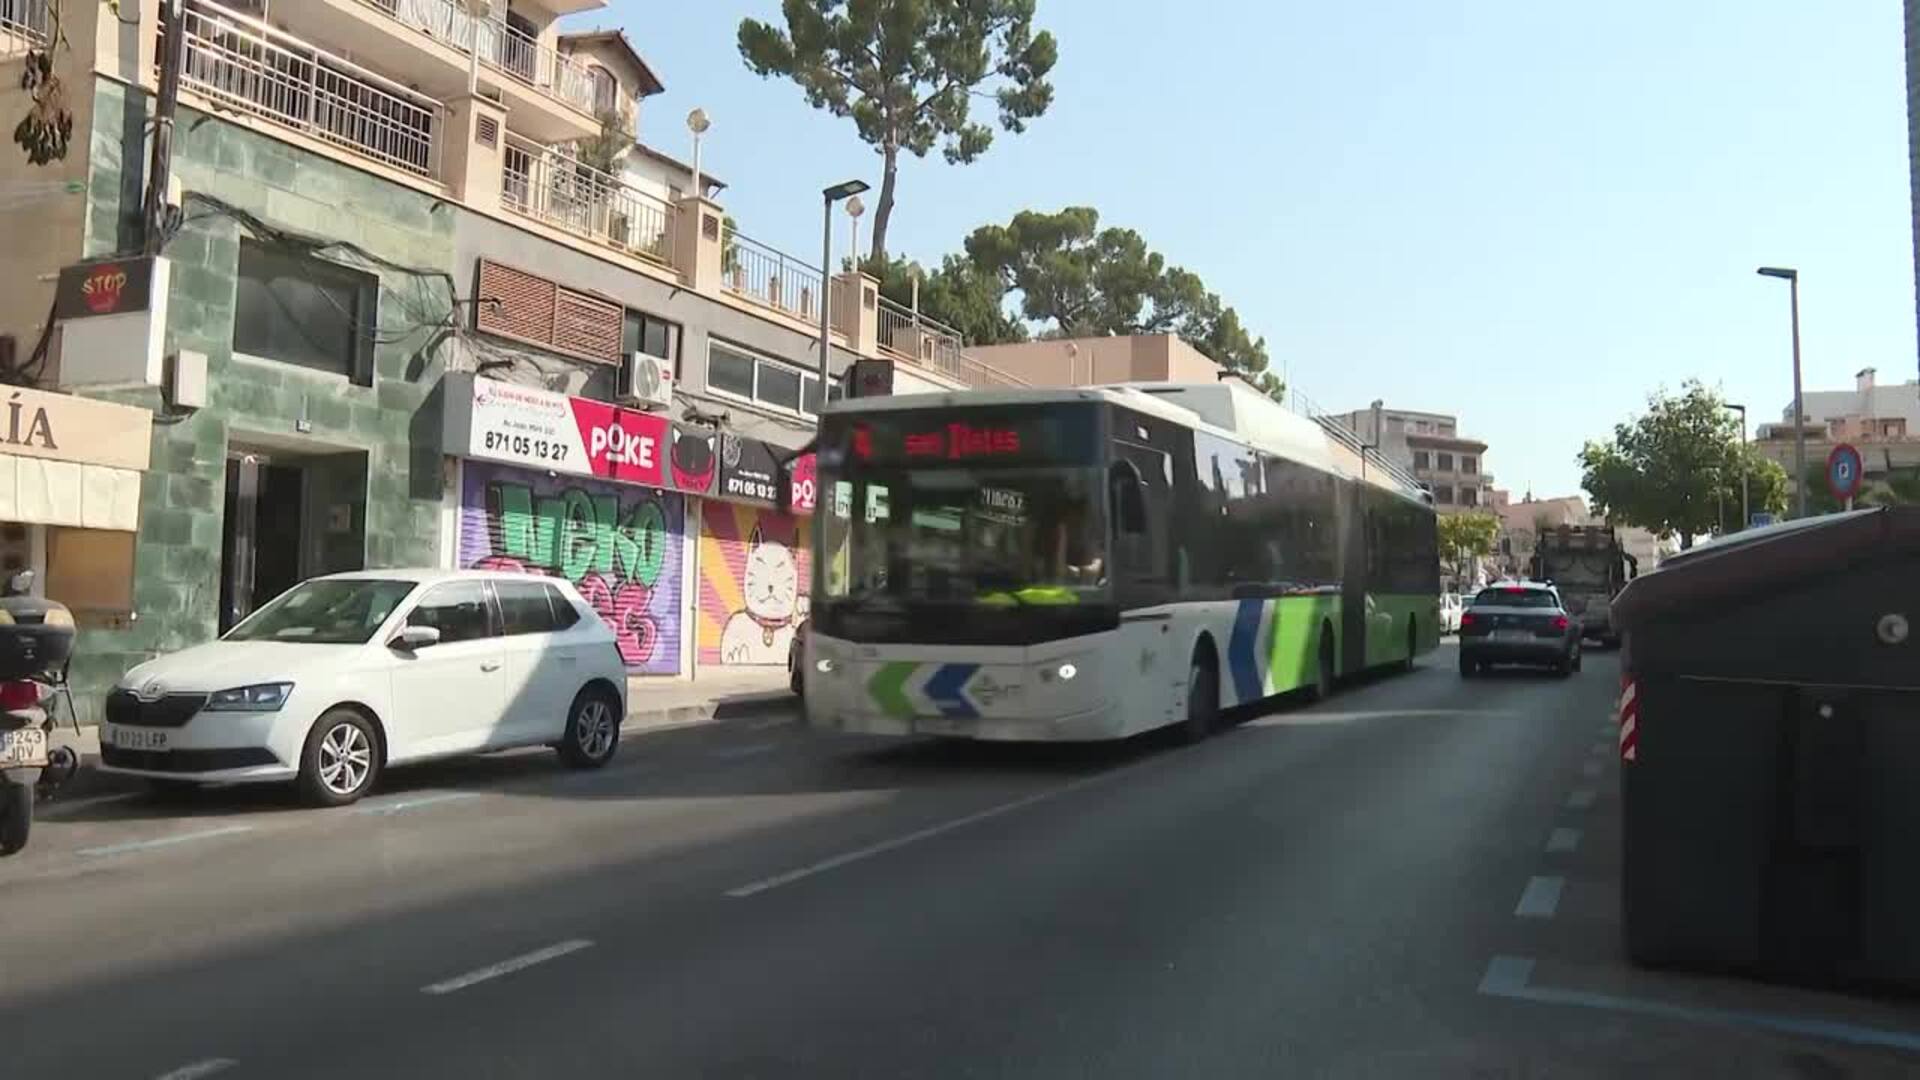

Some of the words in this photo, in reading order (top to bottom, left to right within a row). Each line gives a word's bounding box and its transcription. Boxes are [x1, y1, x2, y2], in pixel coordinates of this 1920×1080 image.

[82, 272, 127, 296] STOP
[0, 392, 58, 450] ÍA
[485, 431, 510, 450] 871
[512, 436, 530, 456] 05
[534, 439, 549, 459] 13
[551, 443, 569, 461] 27
